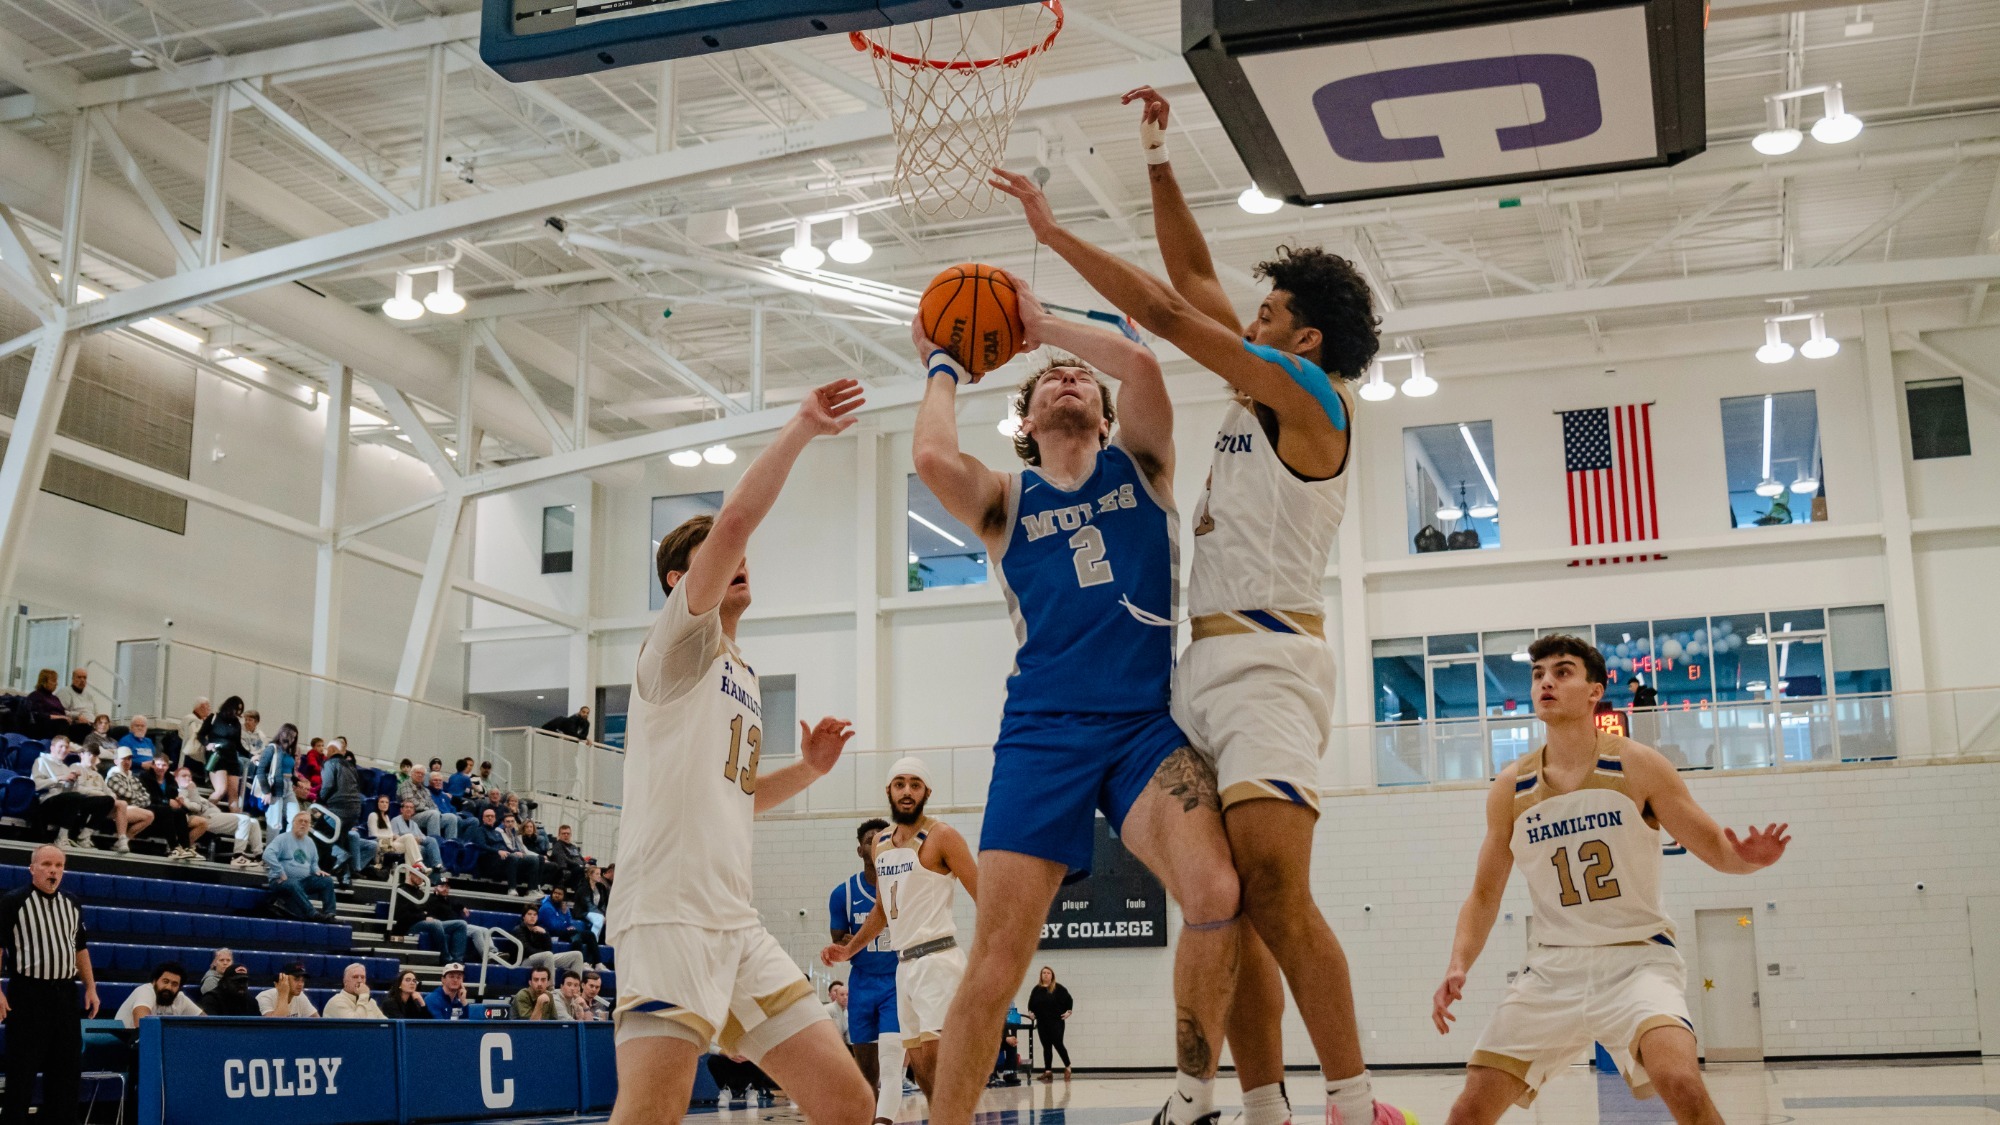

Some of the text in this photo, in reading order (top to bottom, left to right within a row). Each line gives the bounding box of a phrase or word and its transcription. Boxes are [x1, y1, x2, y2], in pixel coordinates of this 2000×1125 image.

[1312, 53, 1602, 163] C
[1069, 525, 1115, 588] 2
[721, 675, 762, 720] HAMILT
[724, 713, 761, 796] 13
[1526, 810, 1623, 844] HAMILTON
[1551, 839, 1621, 907] 12
[890, 880, 898, 920] 1
[1062, 898, 1146, 911] player fouls
[1067, 921, 1154, 938] COLLEGE
[224, 1057, 342, 1098] COLBY
[480, 1032, 514, 1109] C
